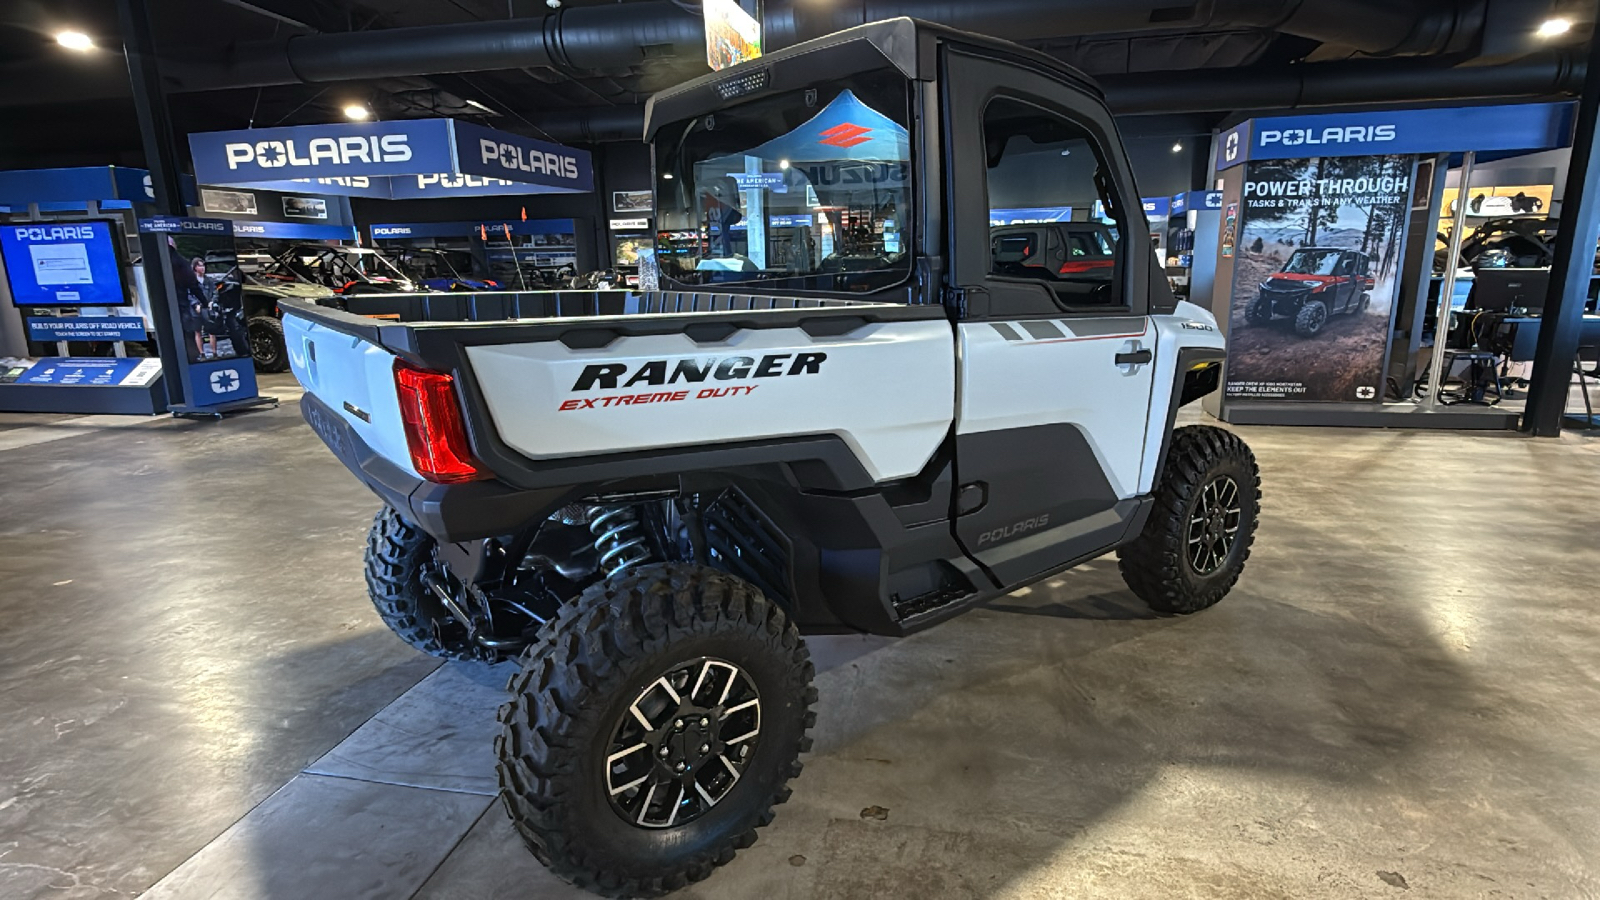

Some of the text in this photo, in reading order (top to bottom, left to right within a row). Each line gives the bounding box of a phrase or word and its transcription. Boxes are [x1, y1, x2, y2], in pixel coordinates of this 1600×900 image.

[1260, 125, 1396, 146] POLARIS
[225, 134, 413, 170] POLARIS
[479, 138, 579, 179] POLARIS
[1244, 176, 1409, 197] POWER THROUGH
[1248, 196, 1401, 208] TASKS & TRAILS IN ANY WEATHER
[15, 227, 94, 240] POLARIS
[181, 222, 224, 231] OLARIS
[374, 227, 412, 235] POLARIS
[571, 352, 827, 391] RANGER
[558, 385, 760, 412] EXTREME DUTY
[978, 514, 1049, 545] POLARIS
